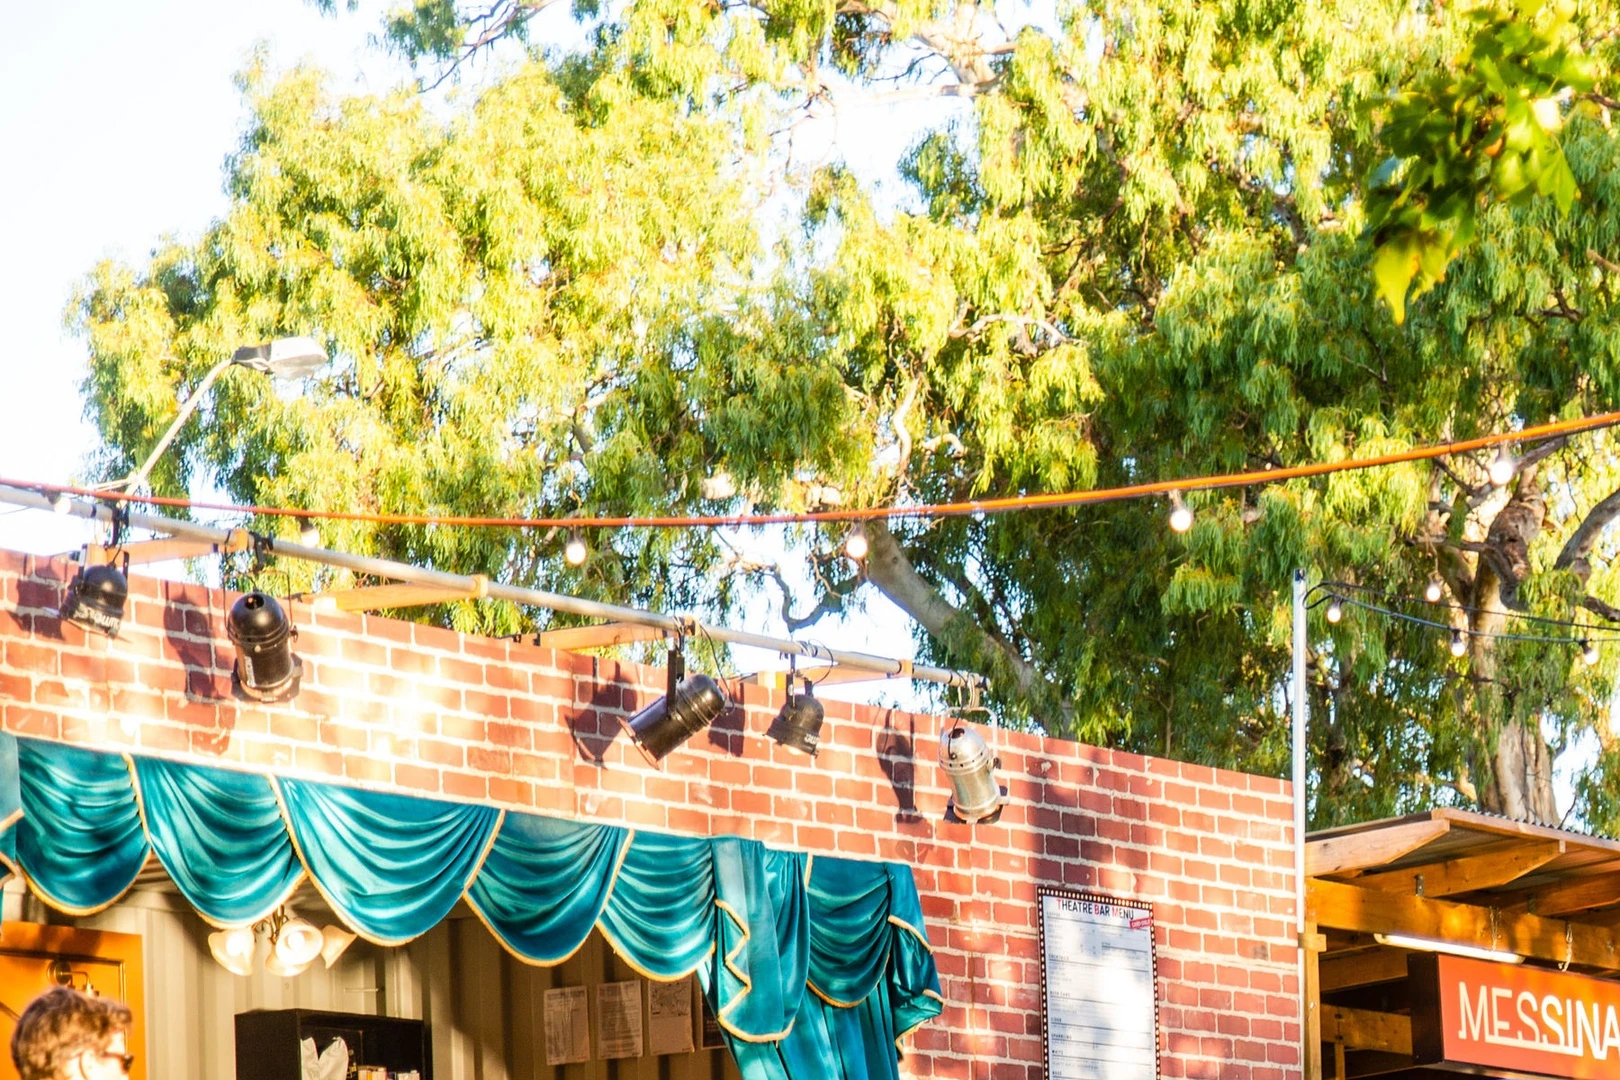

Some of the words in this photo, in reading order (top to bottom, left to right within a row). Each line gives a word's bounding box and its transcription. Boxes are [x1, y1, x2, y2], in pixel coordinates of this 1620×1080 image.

[1056, 898, 1093, 915] THEATRE
[1094, 903, 1110, 917] BAR
[1111, 906, 1134, 920] MENU
